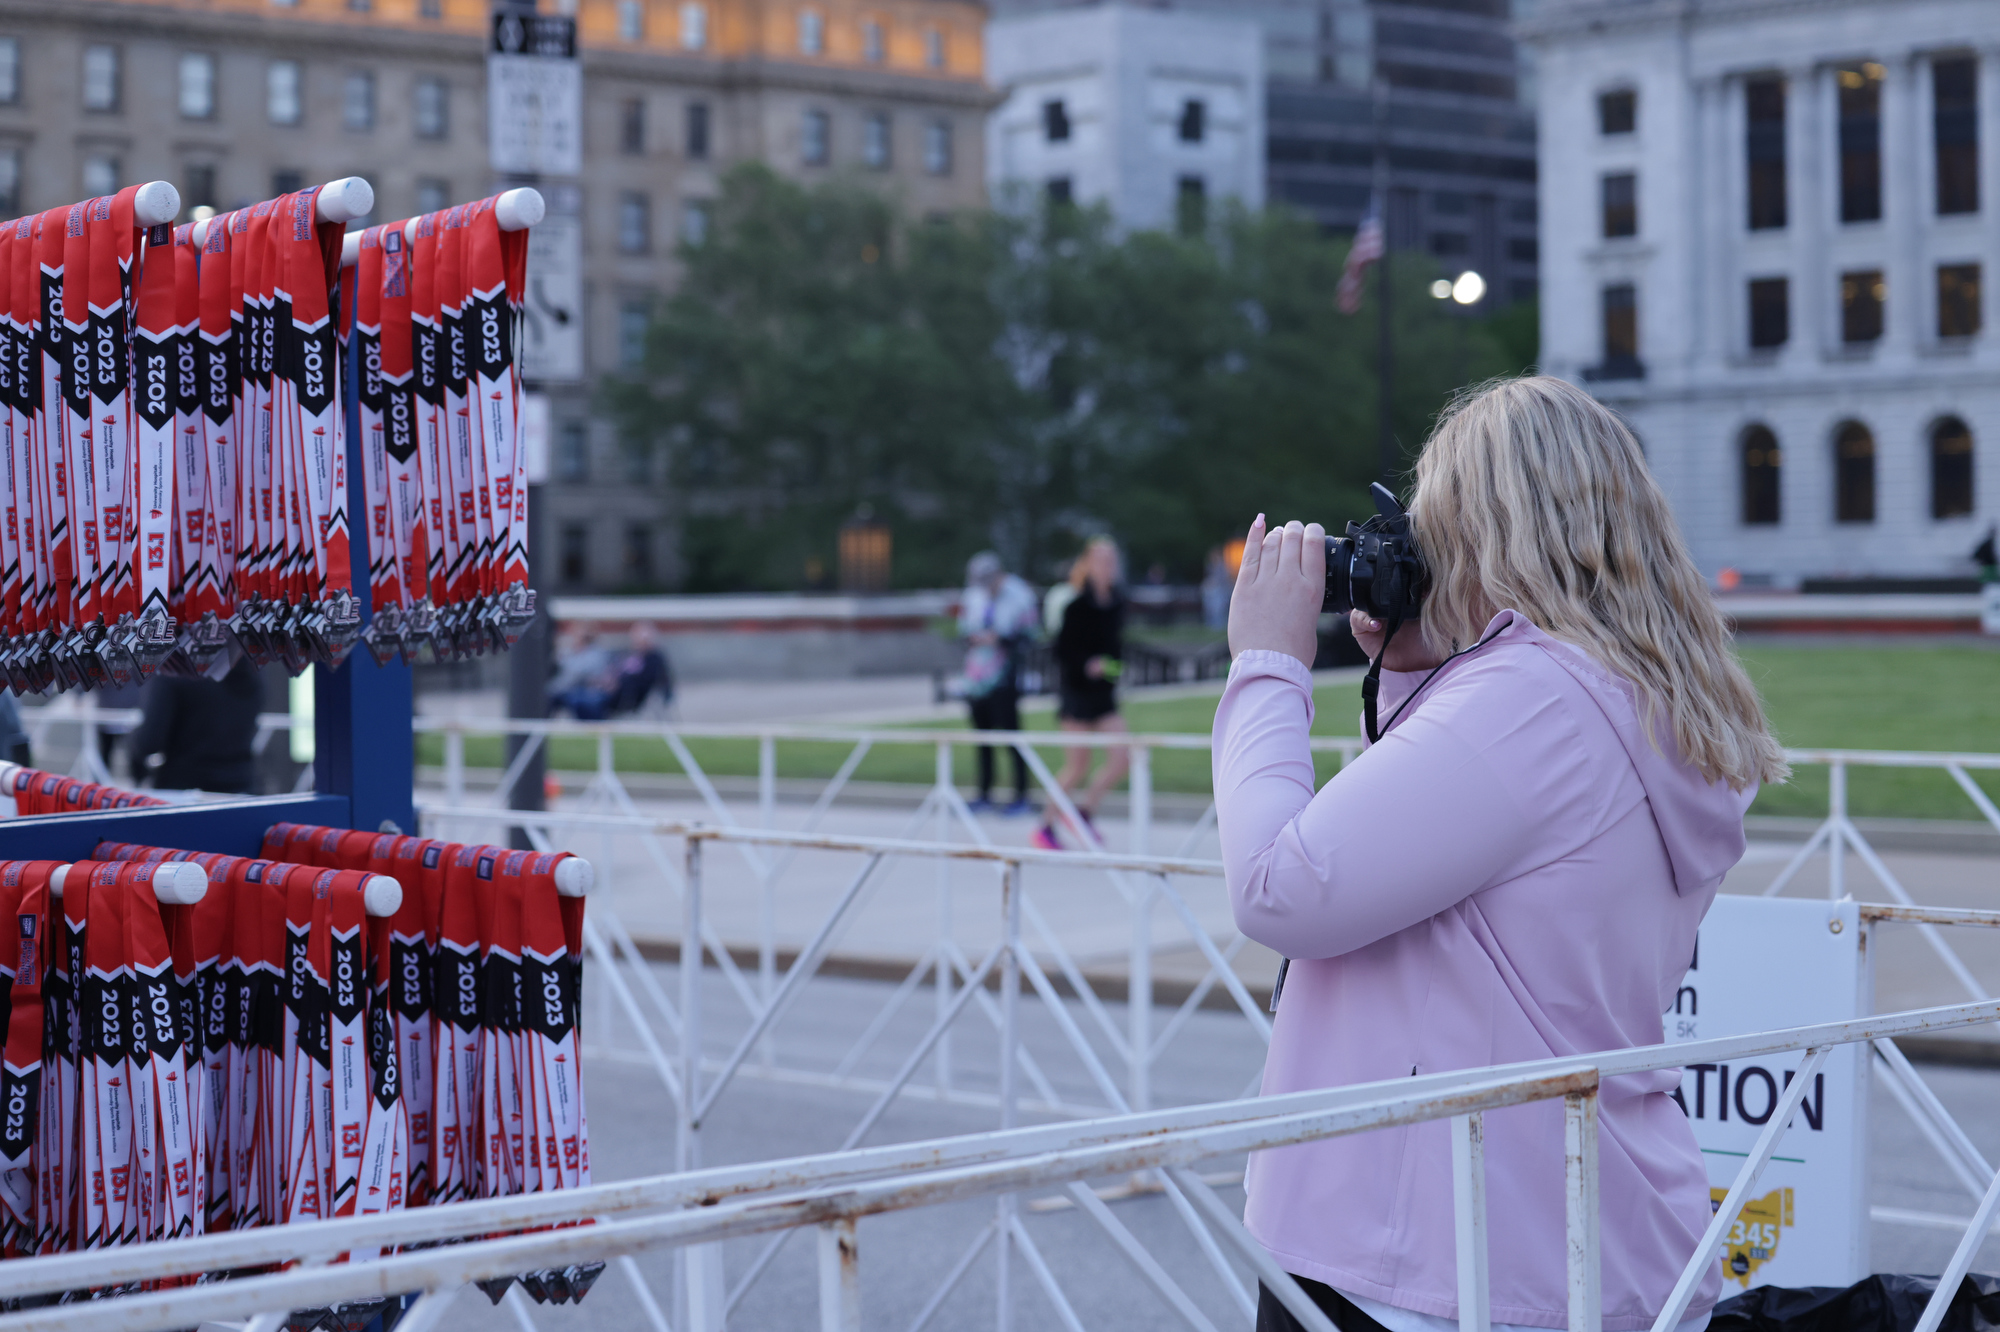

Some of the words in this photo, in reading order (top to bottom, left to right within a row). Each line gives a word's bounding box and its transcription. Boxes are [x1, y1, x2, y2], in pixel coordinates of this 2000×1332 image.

[48, 285, 62, 343] 2023
[481, 307, 501, 363] 2023
[73, 341, 89, 399] 2023
[97, 325, 116, 384] 2023
[178, 342, 196, 397] 2023
[261, 316, 274, 372] 2023
[304, 340, 324, 397] 2023
[366, 342, 382, 395] 2023
[451, 324, 467, 380] 2023
[148, 355, 165, 414] 2023
[209, 351, 227, 407] 2023
[391, 392, 410, 446] 2023
[459, 489, 475, 524] 13.1
[495, 474, 511, 510] 13.1
[103, 504, 121, 542] 13.1
[186, 508, 203, 543] 13.1
[220, 519, 232, 554] 13.1
[148, 532, 165, 570] 13.1
[324, 596, 361, 624] CLE
[501, 589, 537, 616] CLE
[137, 618, 177, 643] CLE
[18, 941, 27, 985] Marathon
[24, 941, 32, 985] Cleveland
[71, 945, 80, 1002] 2023
[337, 949, 354, 1007] 2023
[403, 952, 420, 1006] 2023
[457, 961, 477, 1016] 2023
[102, 988, 120, 1047] 2023
[148, 983, 174, 1042] 2023
[209, 981, 226, 1035] 2023
[541, 970, 564, 1027] 2023
[1677, 1020, 1697, 1038] 5K
[5, 1083, 27, 1141] 2023
[411, 1111, 427, 1145] 13.1
[341, 1121, 360, 1159] 13.1
[563, 1134, 578, 1170] 13.1
[110, 1164, 128, 1202] 13.1
[173, 1158, 189, 1198] 13.1
[299, 1179, 317, 1215] 131
